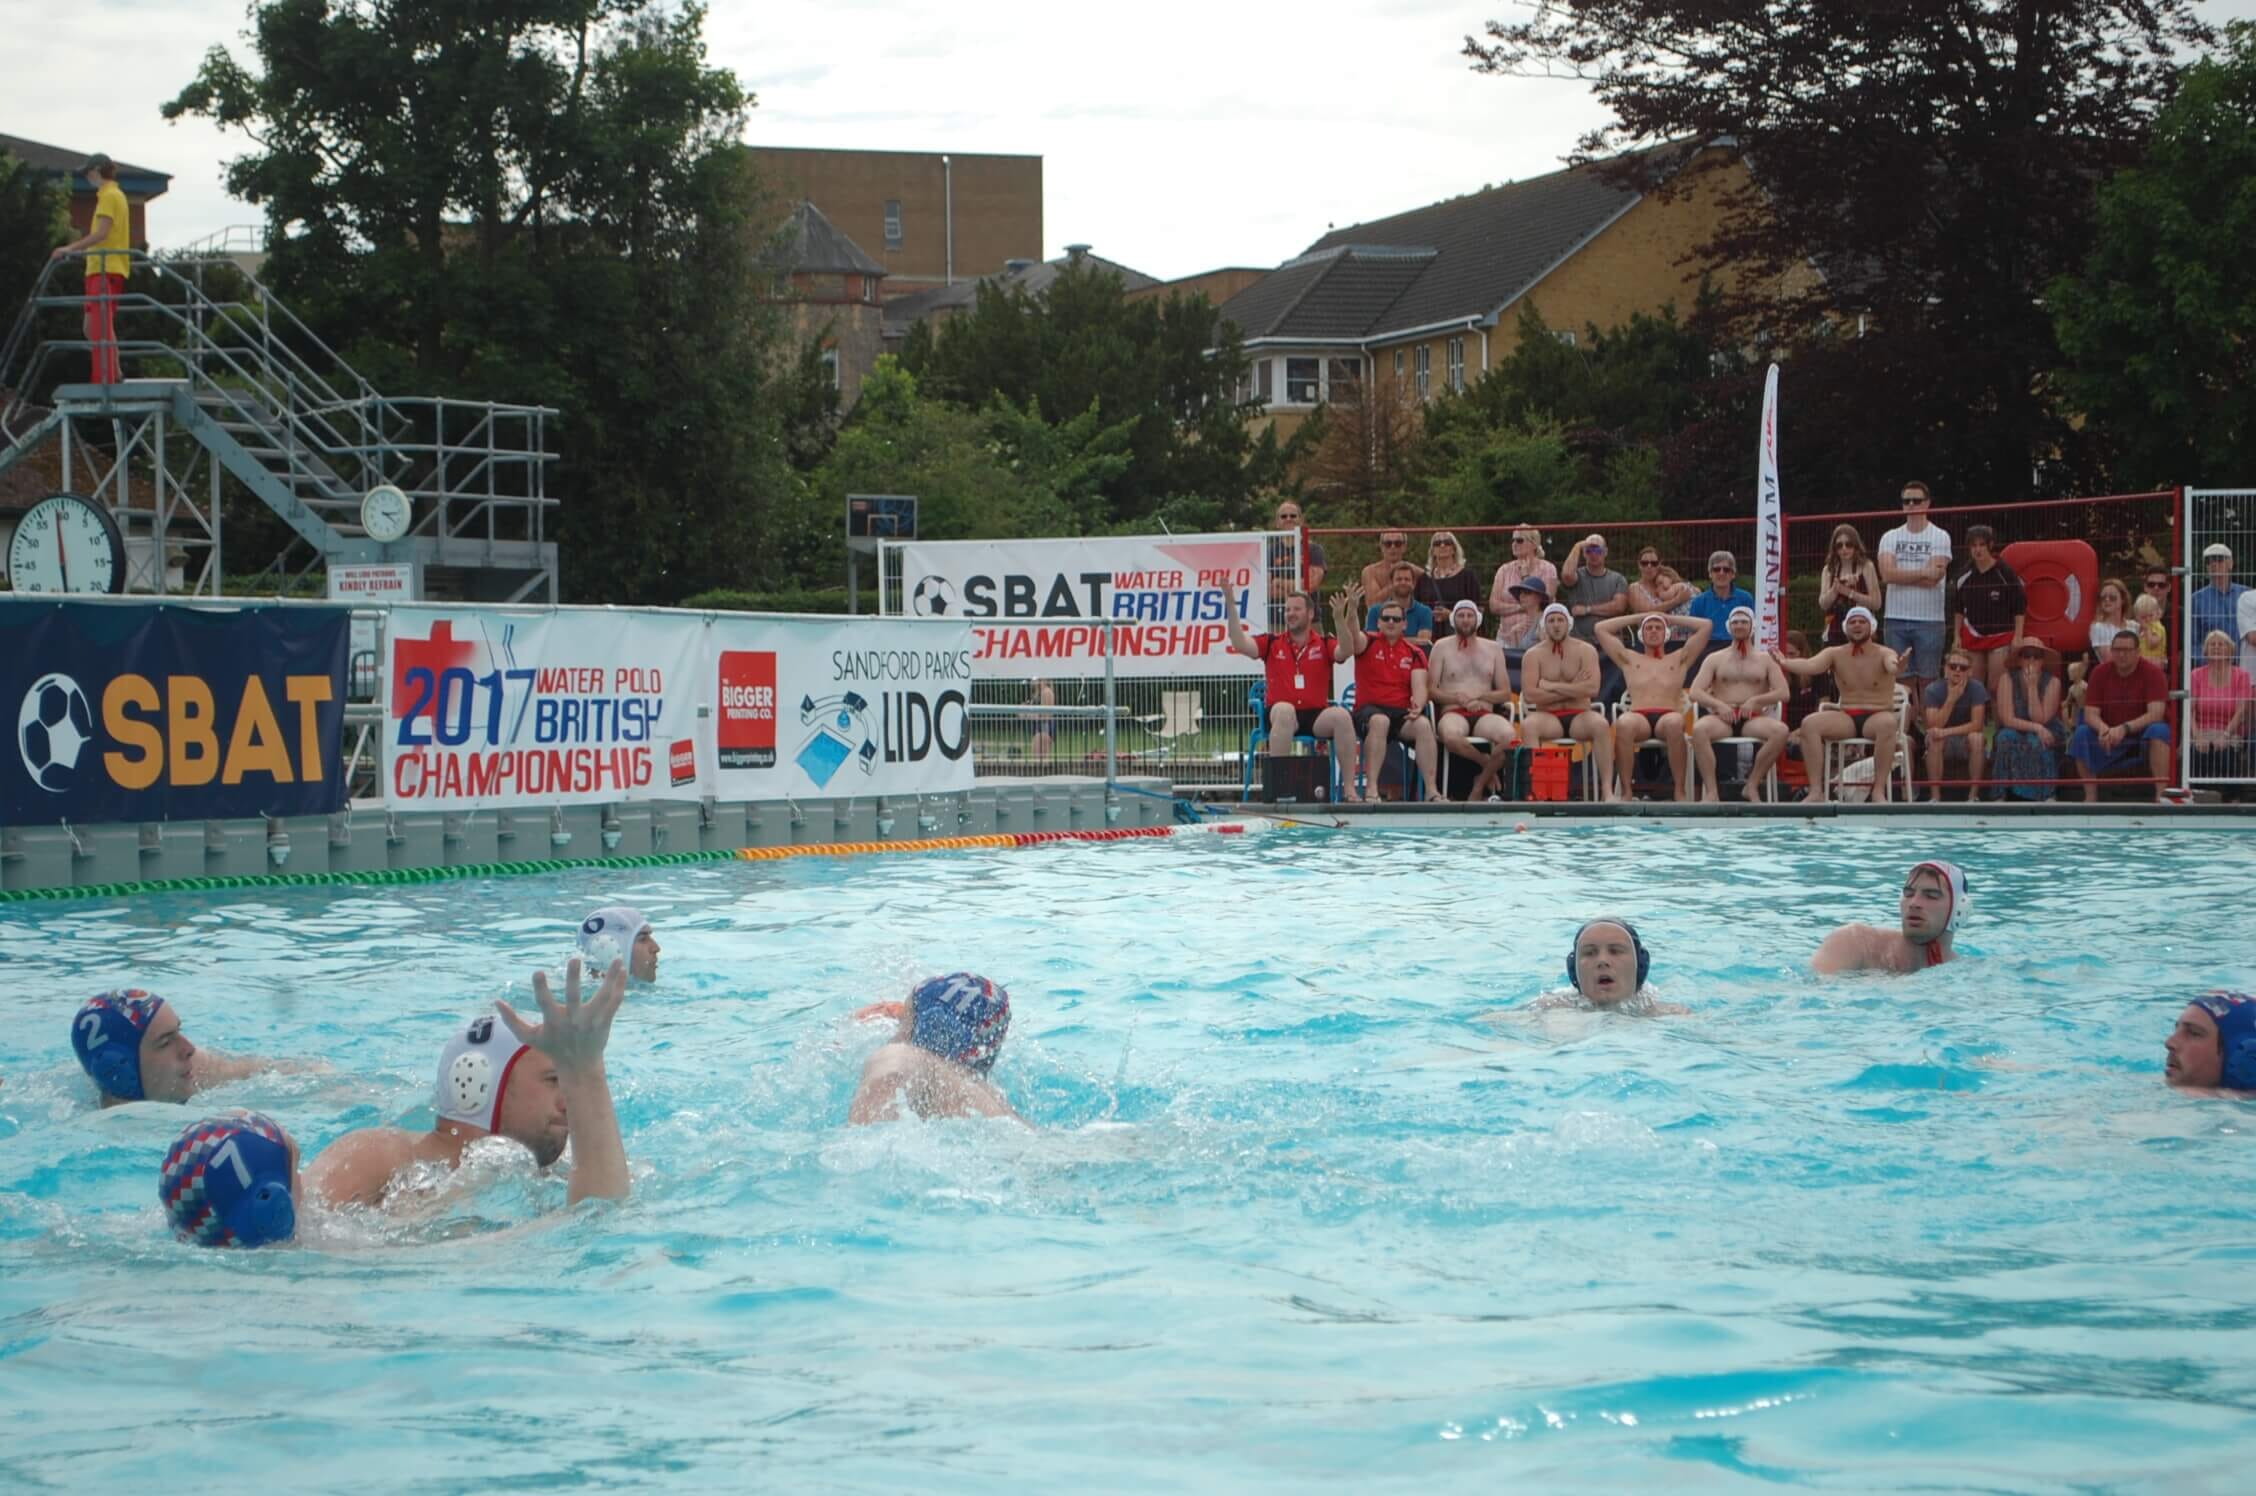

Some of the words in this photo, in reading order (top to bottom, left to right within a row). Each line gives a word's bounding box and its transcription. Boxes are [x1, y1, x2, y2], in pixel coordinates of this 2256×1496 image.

[28, 538, 39, 548] 50
[90, 536, 100, 546] 10
[24, 561, 36, 570] 45
[94, 558, 105, 568] 15
[339, 581, 366, 592] KINDLY
[369, 579, 402, 591] REFRAIN
[1114, 570, 1183, 590] WATER
[963, 572, 1112, 617] SBAT
[832, 650, 921, 681] SANDFORD
[925, 650, 971, 681] PARKS
[536, 667, 604, 694] WATER
[615, 667, 662, 694] POLO
[396, 666, 537, 747] 2017
[722, 685, 774, 708] BIGGER
[101, 672, 333, 791] SBAT
[882, 688, 972, 763] LIDO
[79, 1012, 110, 1051] 2
[209, 1138, 253, 1190] 7
